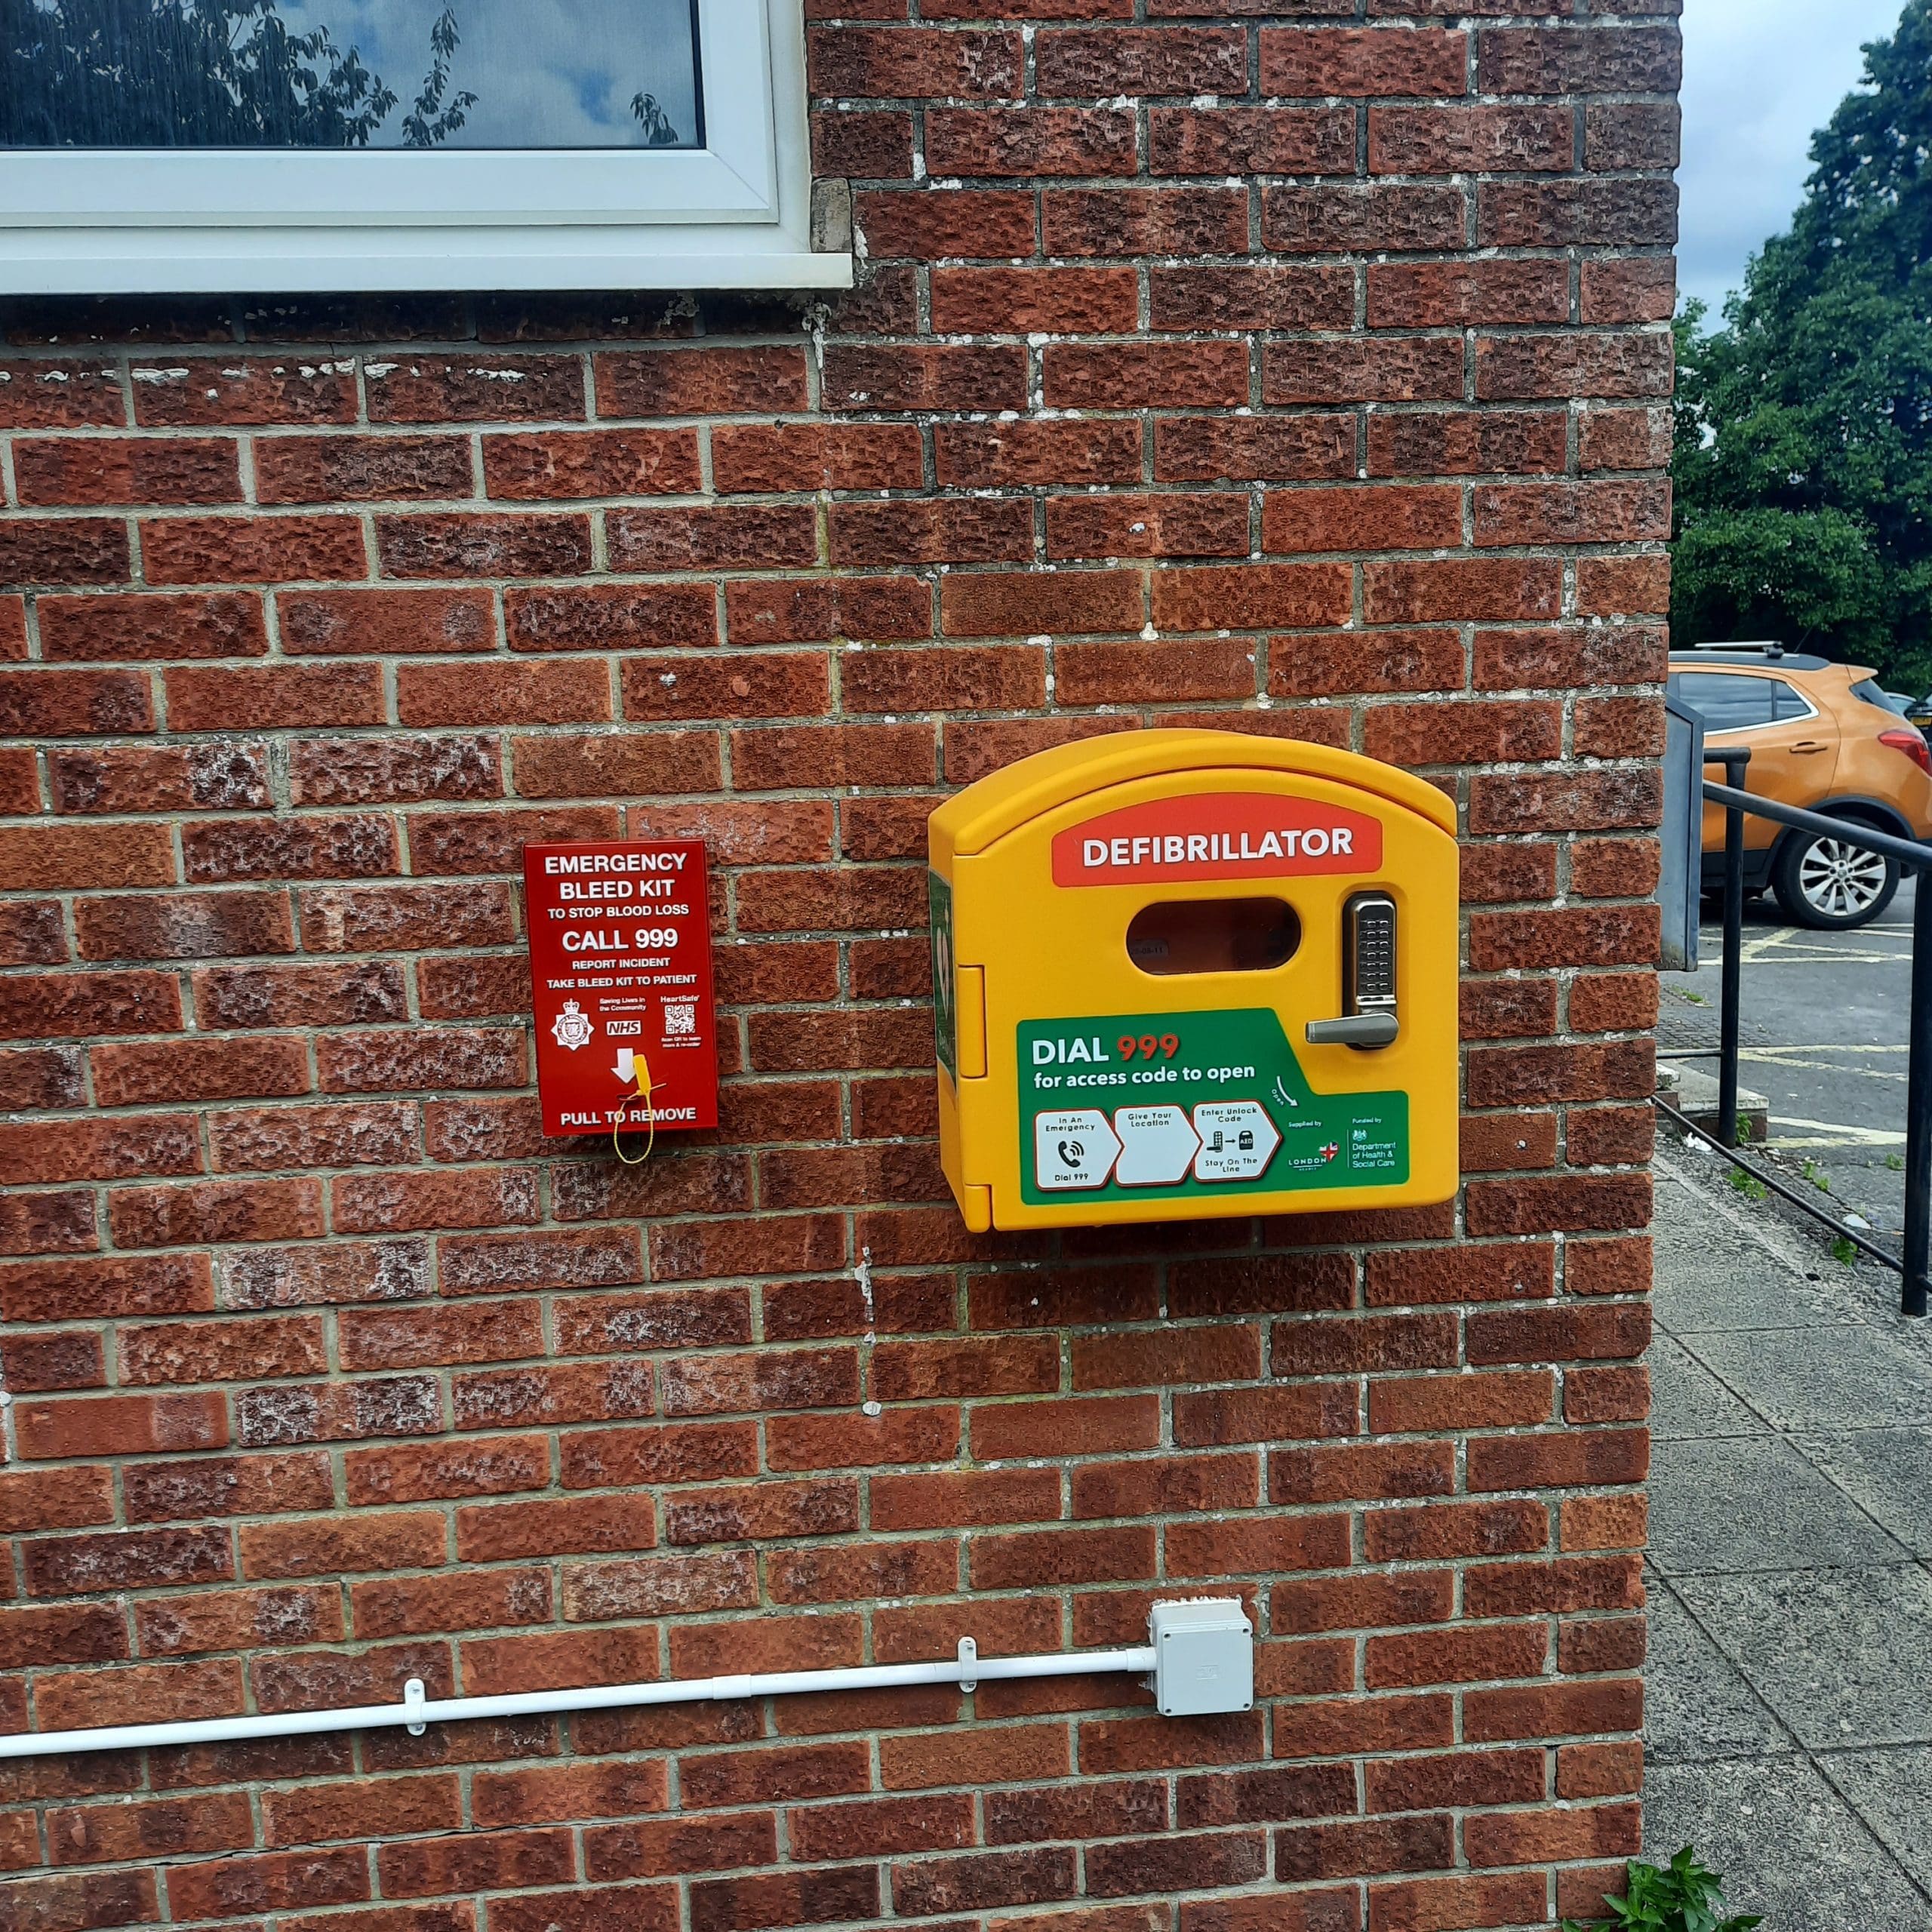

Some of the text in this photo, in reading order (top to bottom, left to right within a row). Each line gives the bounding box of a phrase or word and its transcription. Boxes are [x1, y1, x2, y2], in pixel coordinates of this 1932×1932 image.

[1083, 828, 1353, 867] DEFIBRILLATOR
[545, 853, 688, 874] EMERGENCY
[560, 879, 675, 900] BLEED KIT
[548, 904, 689, 919] TO STOP BLOOD LOSS
[562, 928, 678, 952] CALL 999
[572, 957, 670, 970] REPORT INCIDENT
[546, 974, 697, 989] TAKE BLEED KIT TO PATIENT
[608, 1022, 638, 1034] NHS
[1032, 1032, 1179, 1065] DIAL 999
[1034, 1066, 1255, 1088] for access code to open
[561, 1107, 696, 1125] PULL TO REMOVE
[1352, 1142, 1395, 1151] Department
[1352, 1160, 1375, 1168] Social
